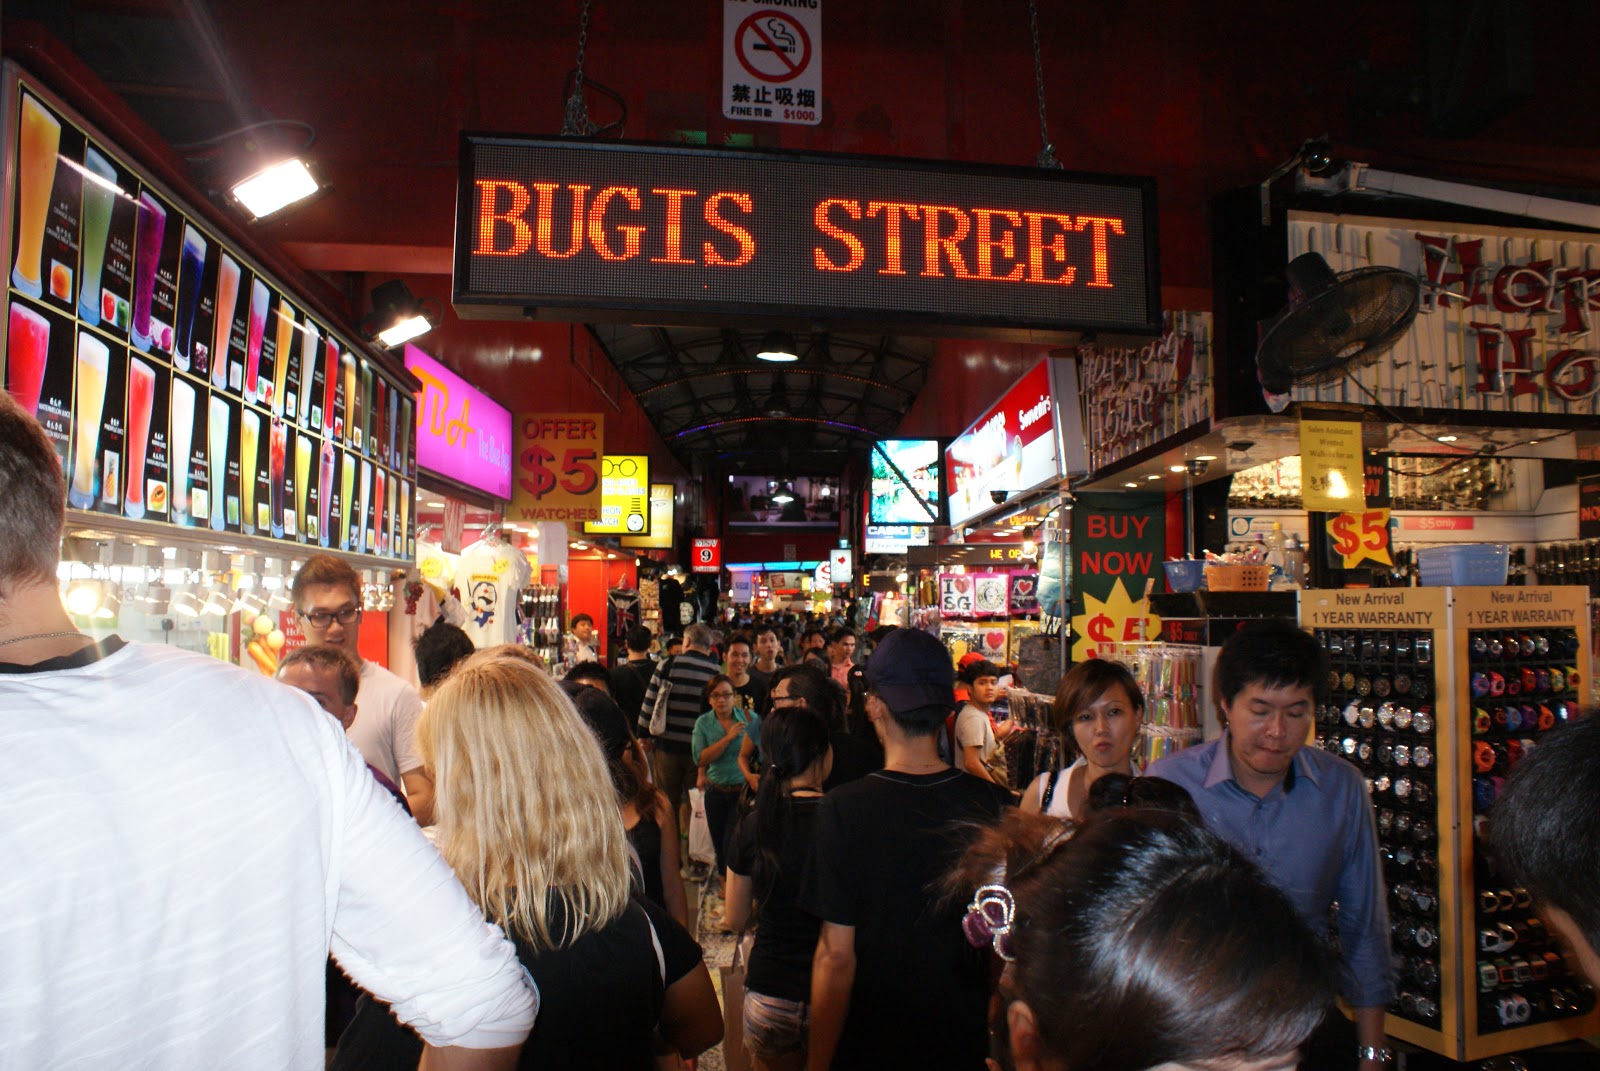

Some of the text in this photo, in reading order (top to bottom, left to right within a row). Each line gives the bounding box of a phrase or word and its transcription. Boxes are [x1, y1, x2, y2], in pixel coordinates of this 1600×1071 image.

[732, 84, 816, 108] 禁止吸烟
[730, 106, 752, 116] FINE
[784, 109, 815, 120] $1000
[471, 179, 1125, 288] BUGIS STREET
[1019, 395, 1051, 431] Souvenirs
[521, 417, 597, 440] OFFER
[518, 444, 598, 500] $5
[520, 507, 598, 520] WATCHES
[603, 507, 621, 515] HION
[1087, 514, 1150, 539] BUY
[1419, 518, 1457, 529] $5 only
[868, 526, 909, 536] CASIO
[1332, 511, 1389, 560] $5
[700, 548, 713, 563] 9
[990, 549, 1003, 559] WE
[1081, 551, 1153, 575] NOW
[944, 596, 971, 610] SG
[1336, 592, 1404, 605] New Arrival
[1491, 590, 1553, 604] New Arrival
[1312, 611, 1433, 625] 1 YEAR WARRANTY
[1467, 610, 1575, 624] 1 YEAR WARRANTY
[1086, 613, 1151, 659] $5
[1169, 621, 1182, 641] $5
